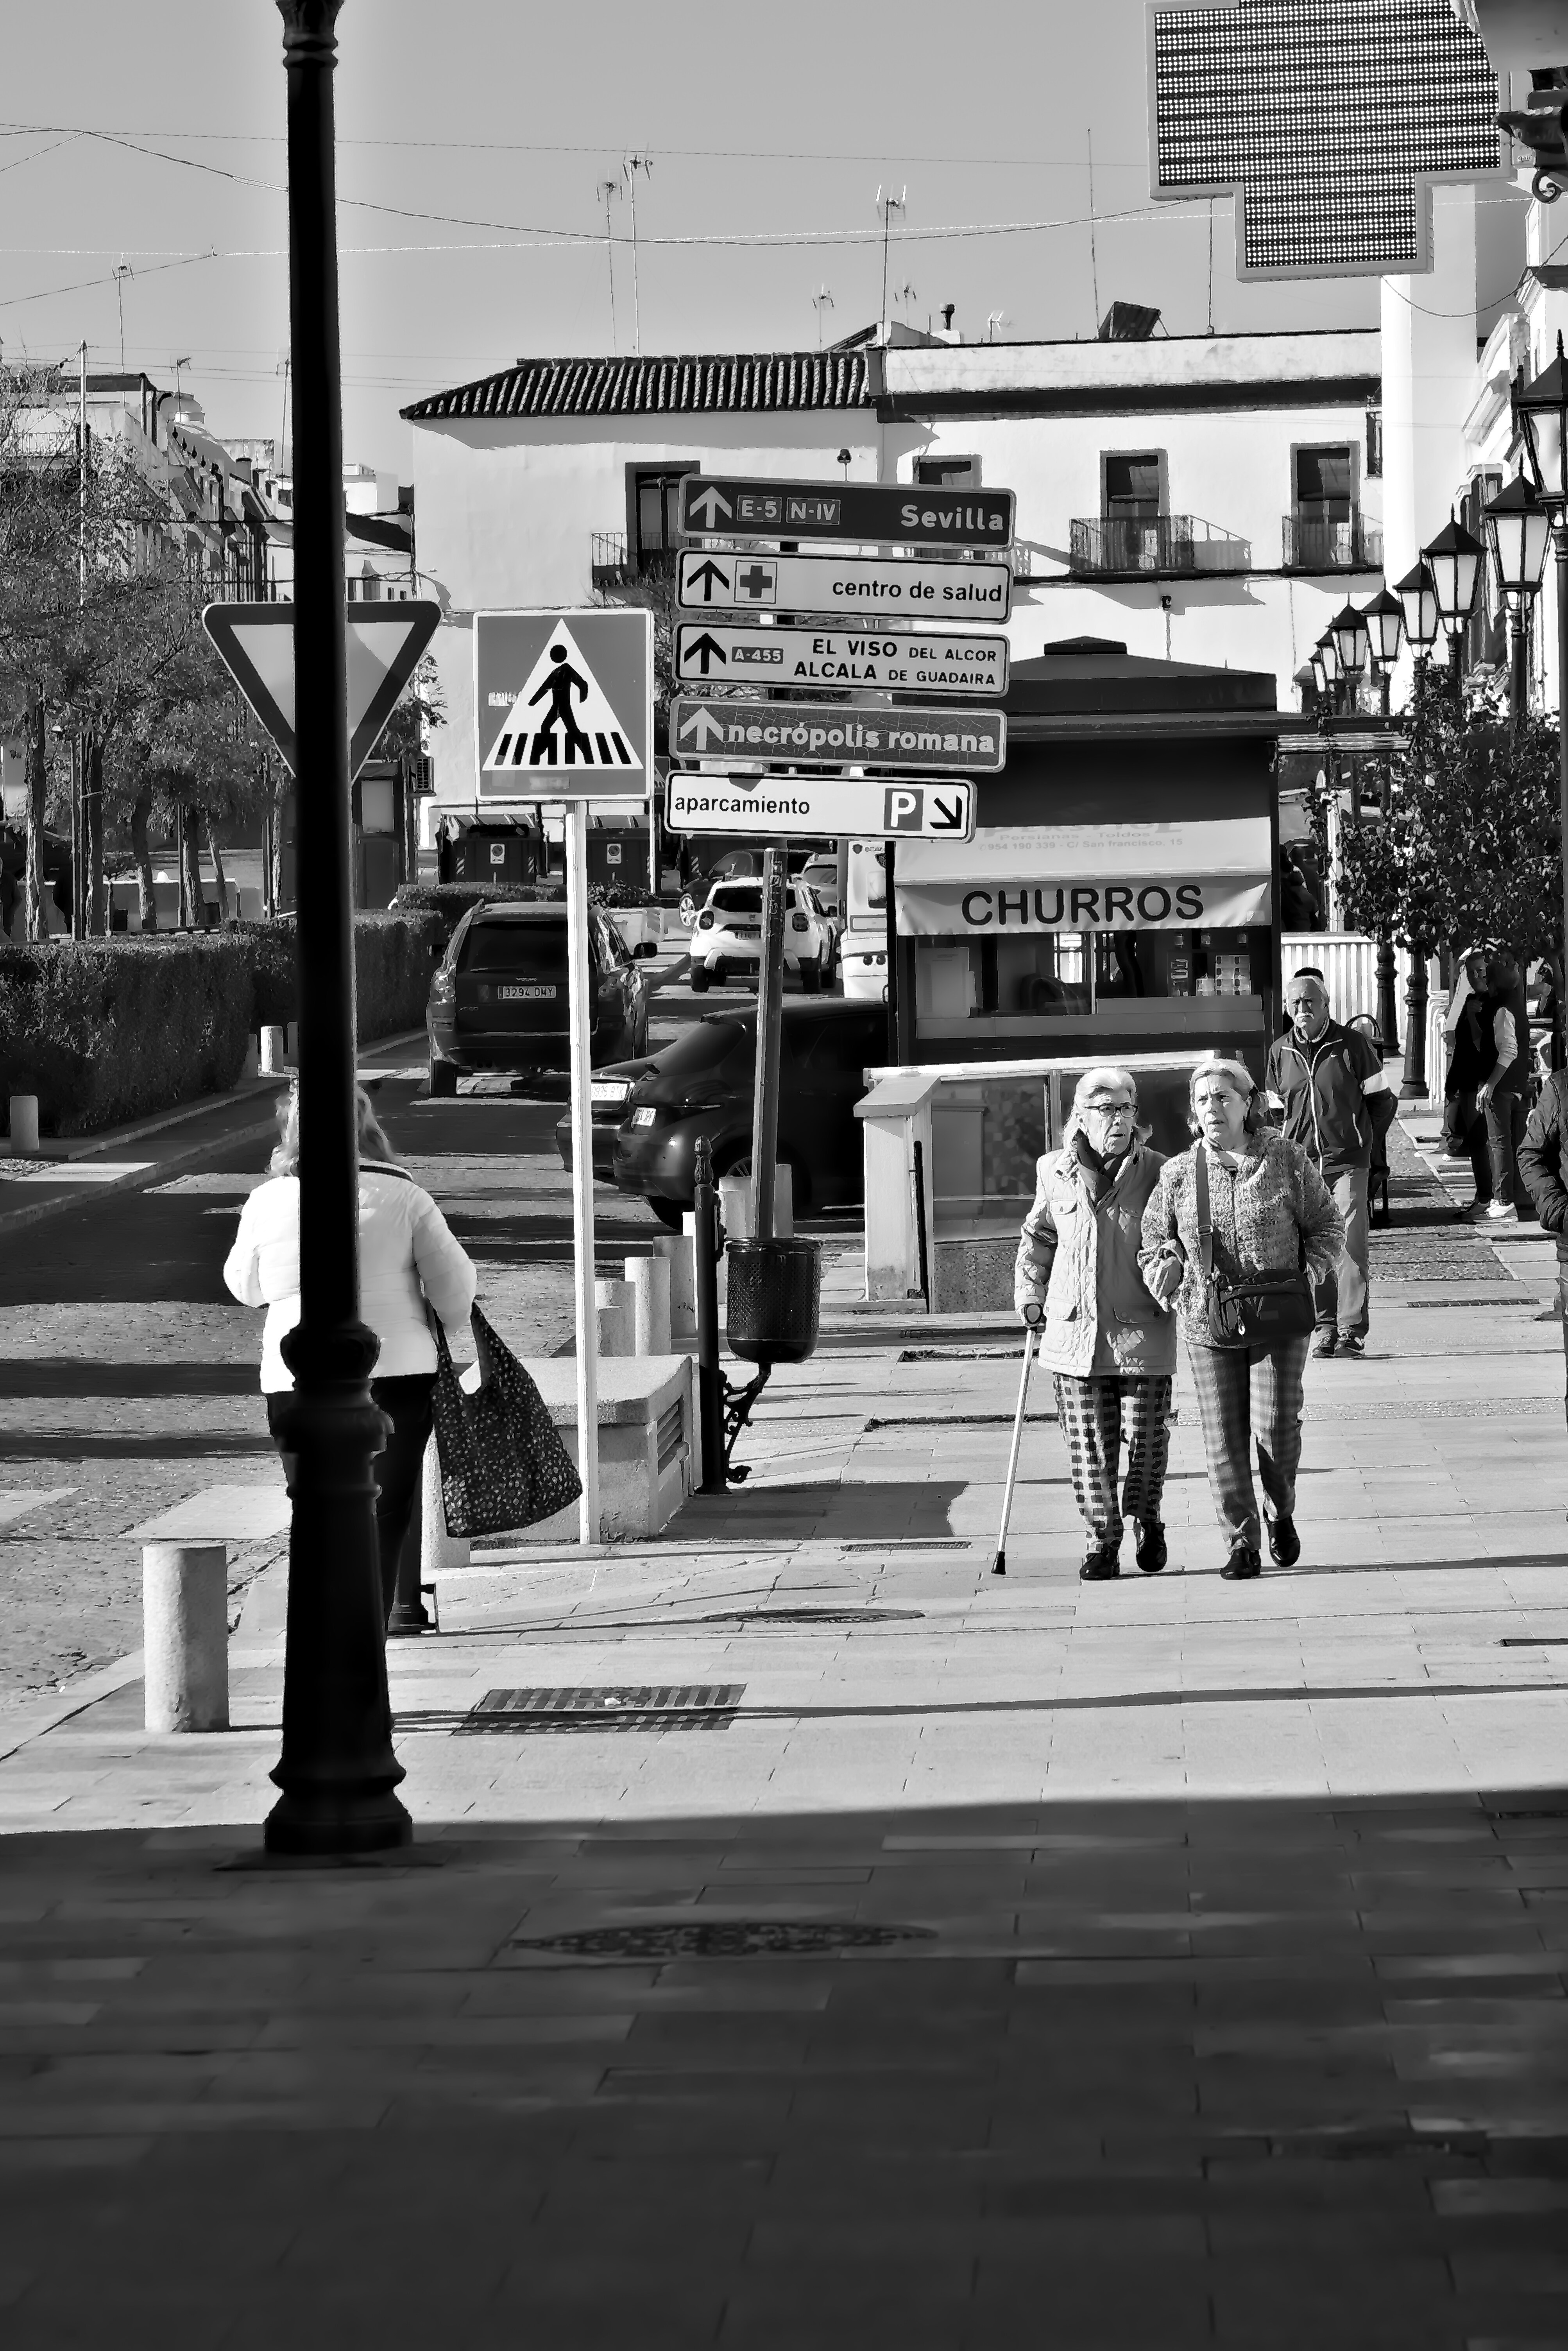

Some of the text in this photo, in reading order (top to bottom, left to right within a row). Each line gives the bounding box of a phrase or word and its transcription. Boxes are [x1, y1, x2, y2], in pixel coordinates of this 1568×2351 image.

[740, 499, 777, 518] E-5
[790, 502, 836, 521] N-IV
[900, 504, 1003, 530] Sevilla
[832, 580, 1002, 602] centro de salud
[732, 647, 781, 662] A-455
[813, 638, 997, 662] EL VISO DEL ALCOR
[794, 661, 995, 685] ALCALA DE GUADAIRA
[728, 722, 994, 753] necrópolis romana
[675, 796, 810, 817] aparcamiento
[890, 792, 916, 828] P
[961, 884, 1204, 926] CHURROS
